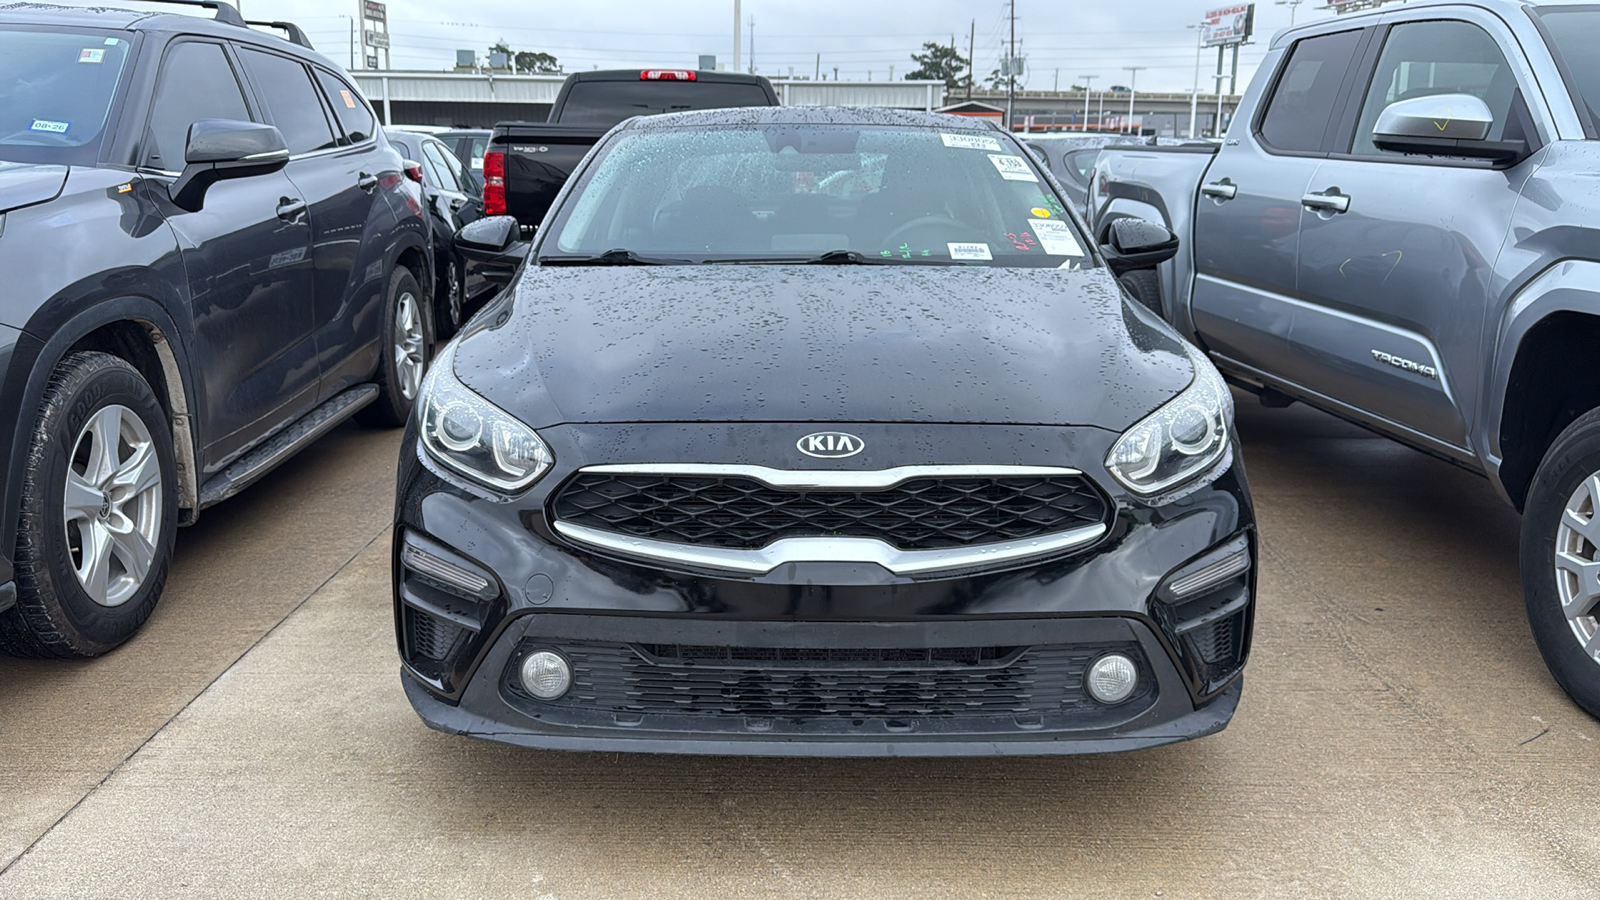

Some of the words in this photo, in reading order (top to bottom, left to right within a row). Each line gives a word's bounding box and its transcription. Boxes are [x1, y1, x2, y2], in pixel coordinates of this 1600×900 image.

[1371, 349, 1437, 379] TACOMA
[71, 375, 142, 427] GOODAR
[808, 435, 855, 451] KIA
